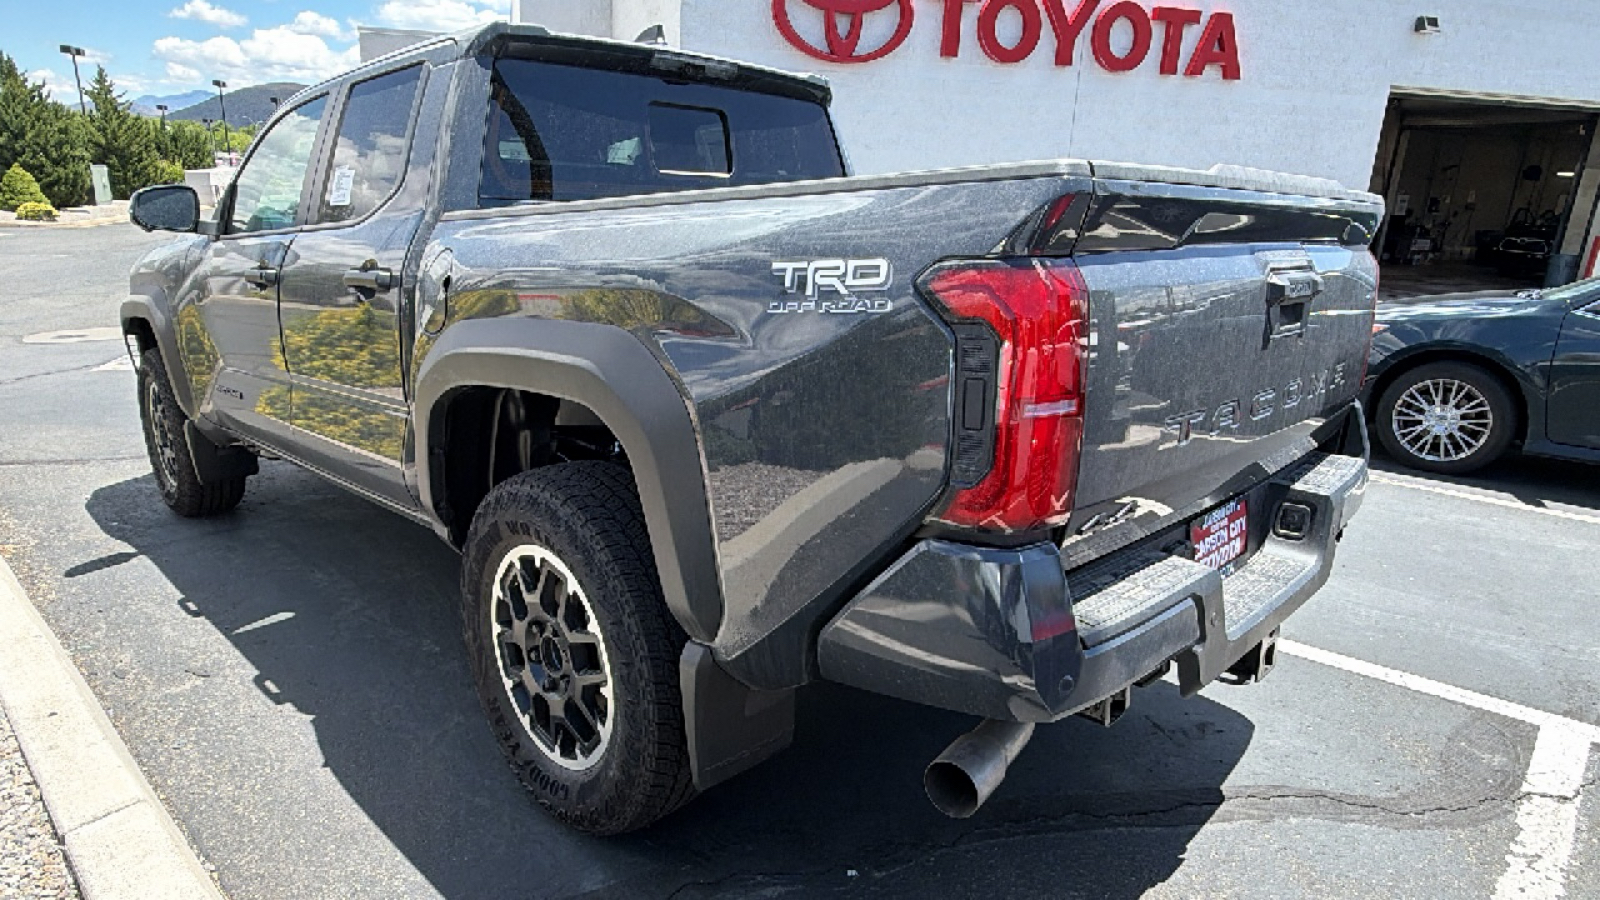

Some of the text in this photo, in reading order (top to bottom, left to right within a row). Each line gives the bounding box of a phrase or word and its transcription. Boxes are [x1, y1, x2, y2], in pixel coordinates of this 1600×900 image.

[940, 0, 1241, 80] TOYOTA
[771, 258, 894, 301] TRD
[766, 299, 894, 314] OFF ROAD
[1164, 362, 1348, 447] TACOMA
[1194, 528, 1228, 561] CARSON
[1229, 515, 1247, 539] CITY
